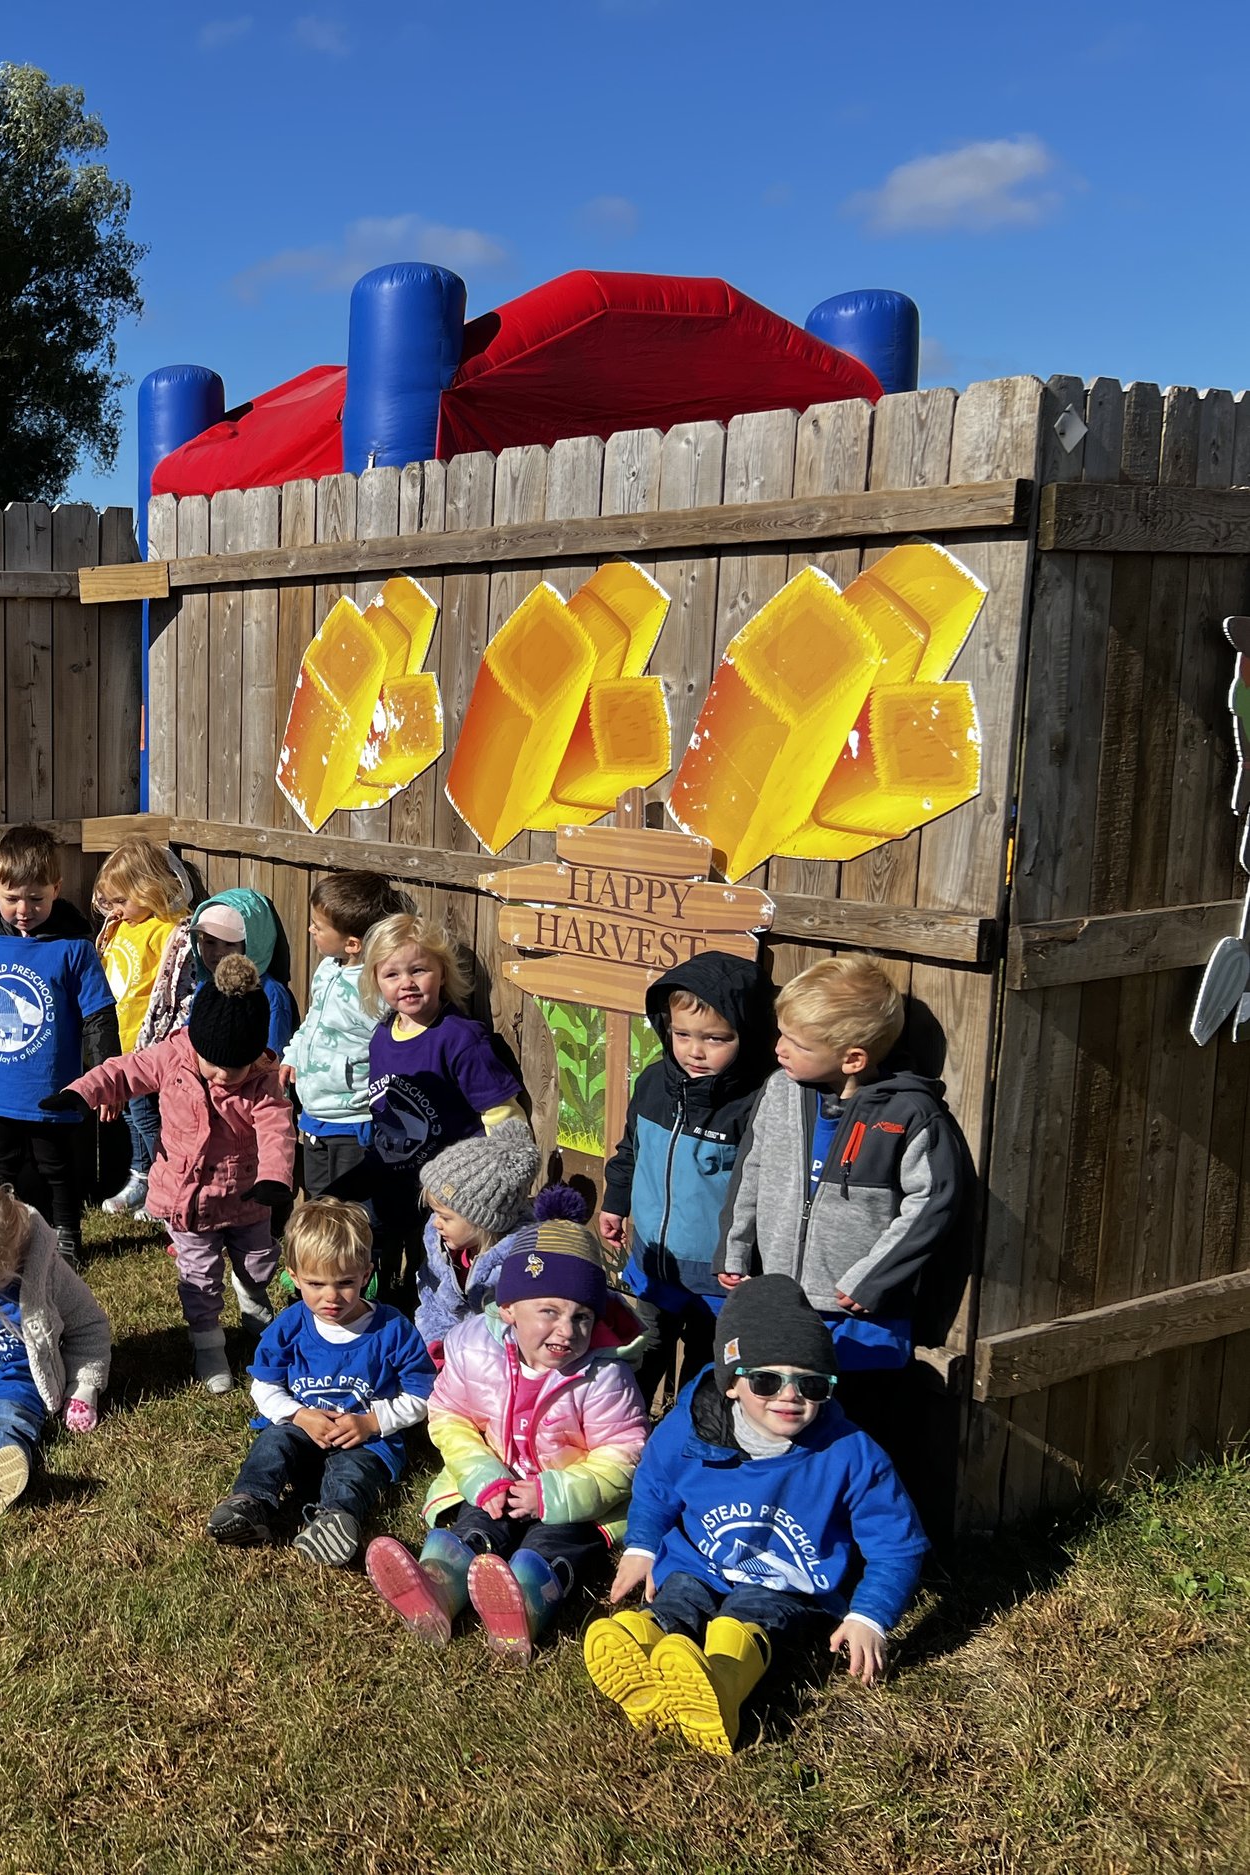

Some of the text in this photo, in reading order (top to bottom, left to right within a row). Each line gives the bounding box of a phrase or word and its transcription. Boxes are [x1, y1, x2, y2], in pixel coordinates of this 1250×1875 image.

[567, 866, 695, 920] HAPPY
[534, 911, 707, 969] HARVEST
[11, 963, 54, 1011] PRESCHOOL
[12, 1054, 19, 1062] is
[25, 1039, 43, 1056] field
[40, 1028, 53, 1042] trip
[391, 1074, 439, 1123] PRESCHOOL
[759, 1504, 821, 1573] PRESCHOOL
